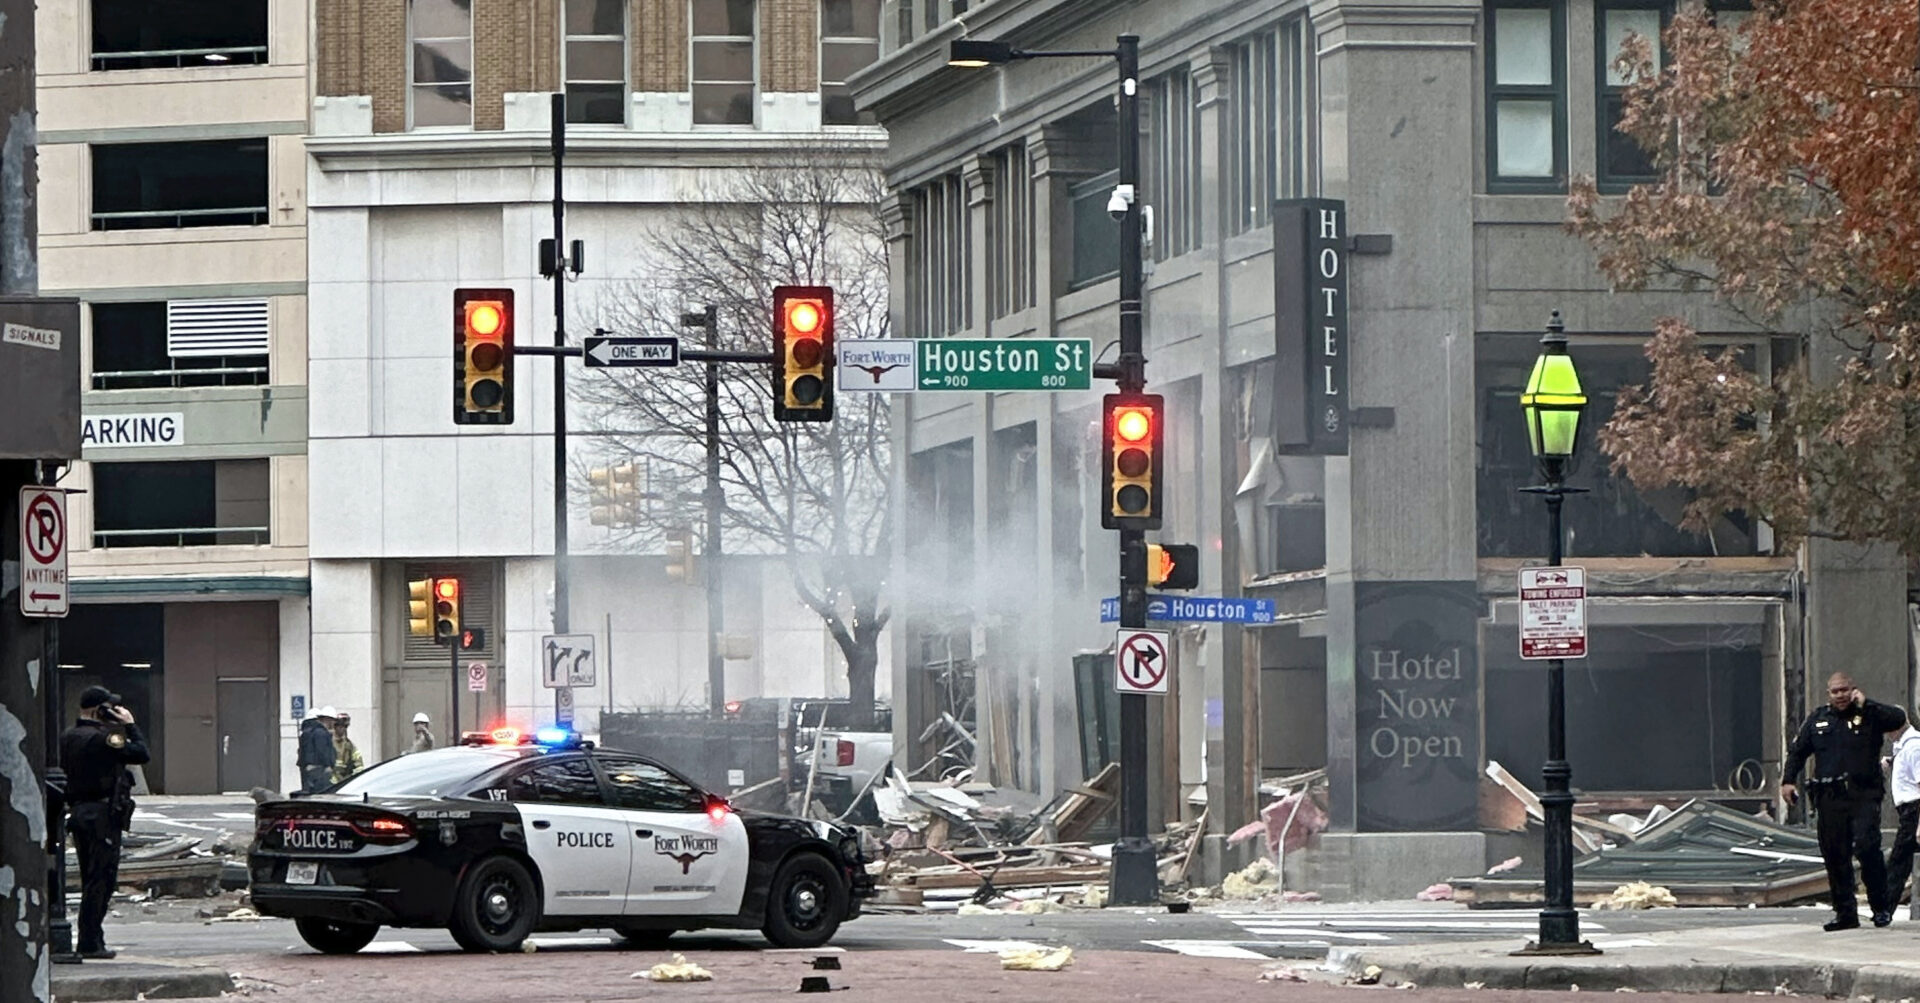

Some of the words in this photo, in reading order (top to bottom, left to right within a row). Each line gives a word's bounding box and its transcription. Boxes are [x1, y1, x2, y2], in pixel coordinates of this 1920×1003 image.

[1319, 208, 1339, 396] HOTEL
[9, 327, 56, 345] SIGNALS
[612, 346, 637, 359] ONE
[642, 346, 668, 358] WAY
[843, 350, 870, 363] FORT
[871, 350, 911, 363] WORTH
[925, 343, 1039, 372] Houston
[1055, 343, 1084, 372] St
[944, 375, 968, 387] 900
[1041, 375, 1066, 387] 800
[82, 417, 175, 444] ARKING
[26, 568, 65, 584] ANYTIME
[1172, 599, 1245, 619] Houston
[1371, 648, 1461, 680] Hotel
[1377, 689, 1456, 718] Now
[1370, 727, 1464, 767] Open
[487, 789, 507, 800] 197
[283, 829, 337, 849] POLICE
[557, 832, 614, 848] POLICE
[654, 835, 679, 850] FORT
[681, 835, 718, 850] WORTH
